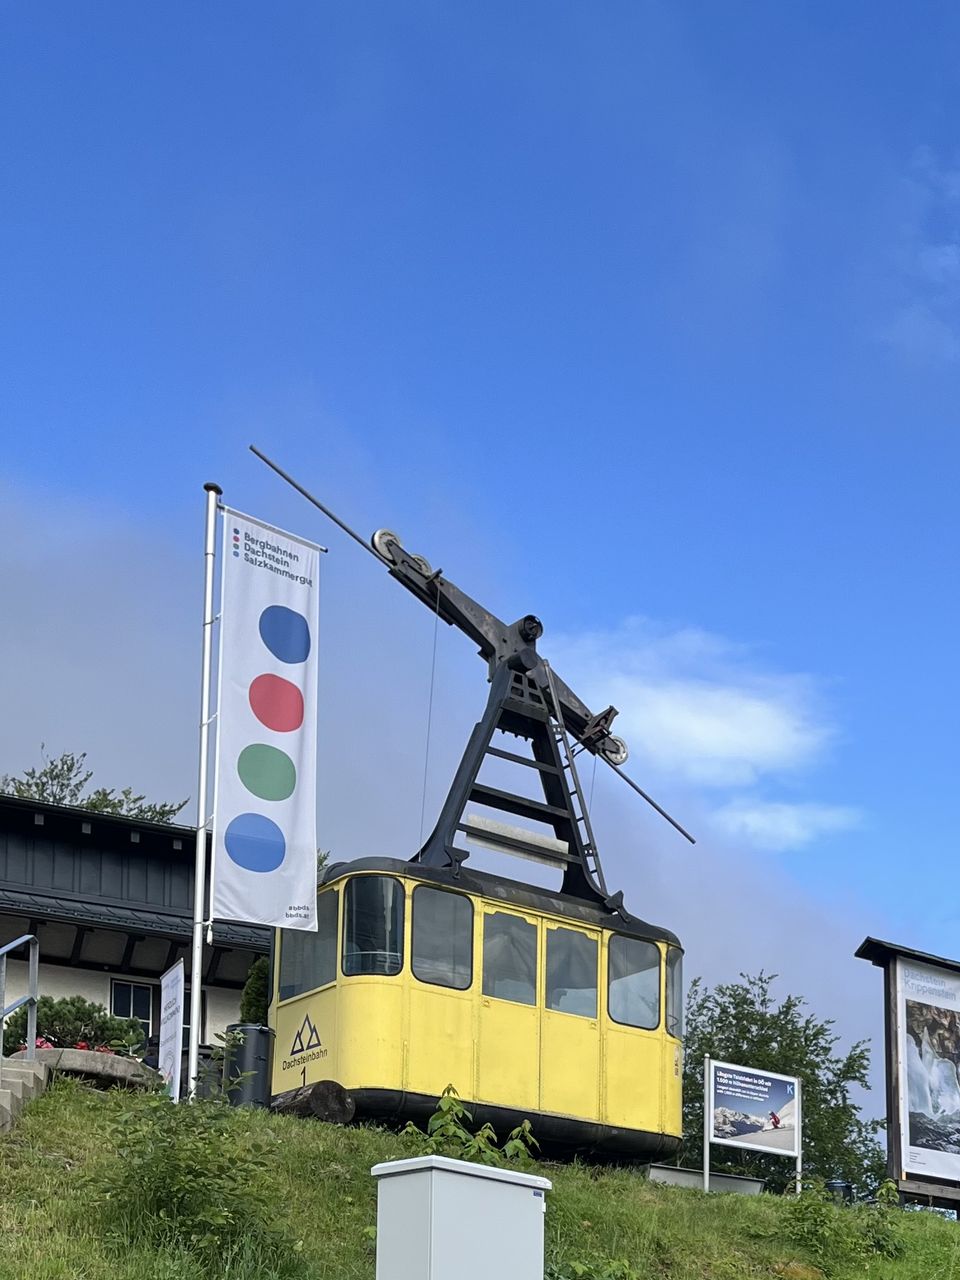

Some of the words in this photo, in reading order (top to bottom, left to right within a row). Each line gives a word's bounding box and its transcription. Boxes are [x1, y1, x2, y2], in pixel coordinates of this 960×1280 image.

[243, 532, 300, 562] Bergbahnen
[243, 542, 290, 567] Dachstein
[903, 969, 946, 987] Dachstein
[904, 979, 957, 1001] Krippenstein
[282, 1048, 328, 1071] Dachsteinbahn
[300, 1066, 306, 1087] 1
